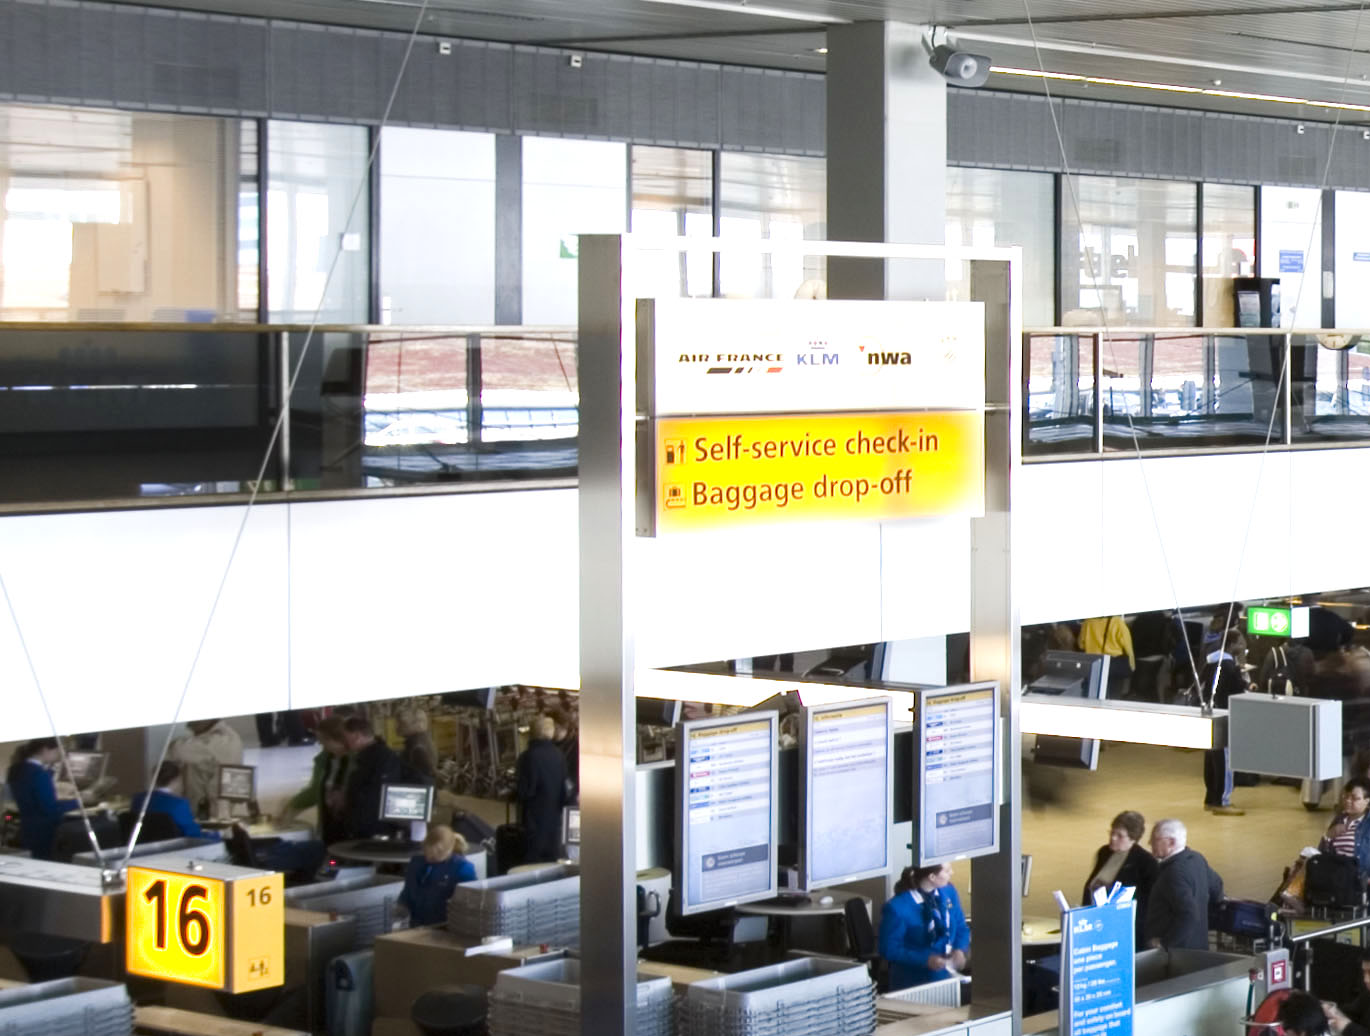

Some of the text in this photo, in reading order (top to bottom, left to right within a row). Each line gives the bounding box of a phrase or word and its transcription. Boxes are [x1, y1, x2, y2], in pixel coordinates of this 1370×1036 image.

[678, 352, 785, 364] AIR FRANCE
[797, 352, 839, 367] KLM
[867, 349, 912, 366] nwa
[694, 428, 939, 464] Self-service check-in
[692, 469, 913, 511] Baggage drop-off
[246, 885, 272, 907] 16
[143, 879, 210, 957] 16
